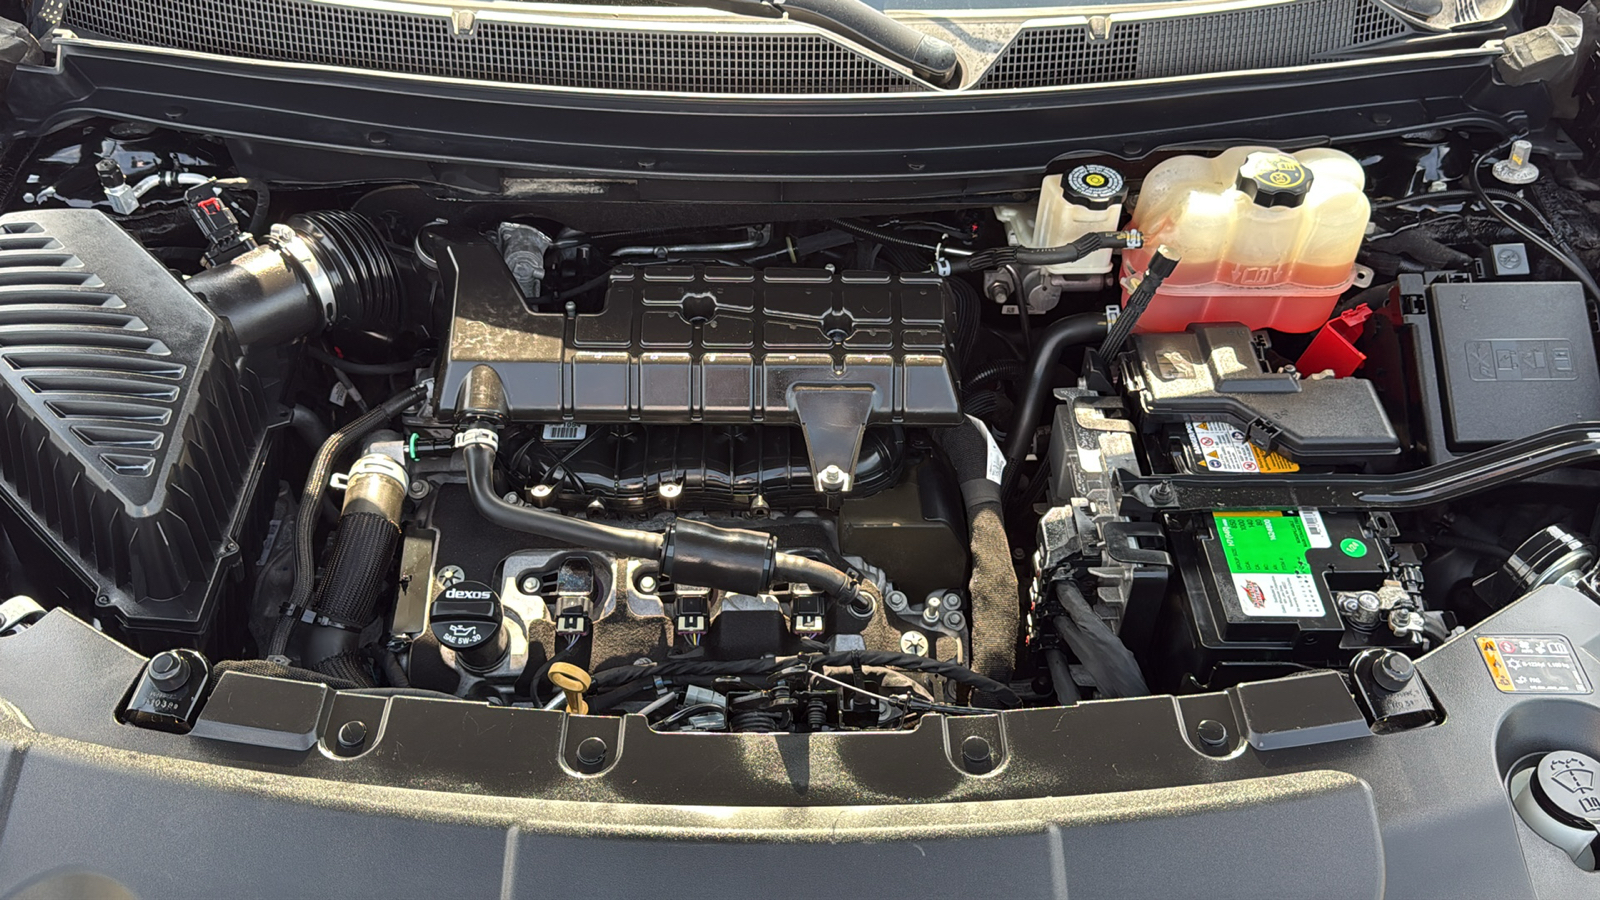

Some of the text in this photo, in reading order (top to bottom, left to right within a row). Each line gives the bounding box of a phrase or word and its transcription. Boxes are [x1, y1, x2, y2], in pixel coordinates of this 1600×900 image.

[445, 588, 492, 599] dexos
[443, 633, 482, 645] SAE 5W-30
